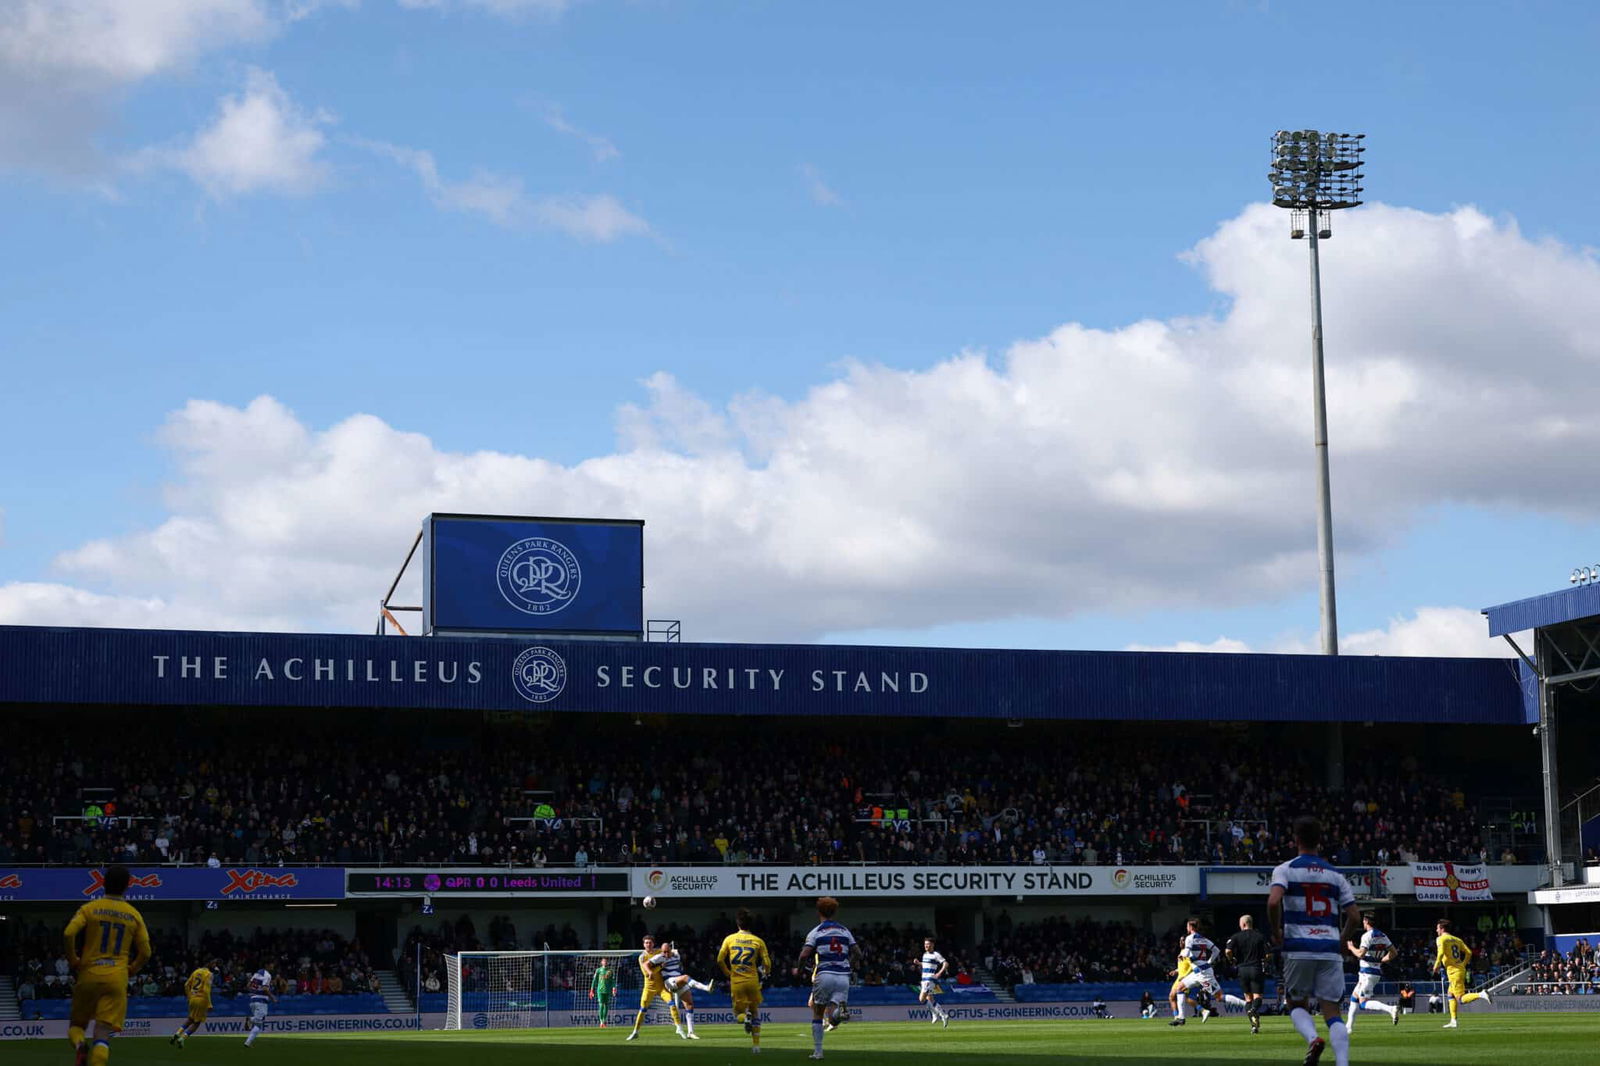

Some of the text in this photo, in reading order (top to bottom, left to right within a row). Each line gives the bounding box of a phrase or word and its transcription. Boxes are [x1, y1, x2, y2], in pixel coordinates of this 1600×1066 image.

[501, 540, 578, 579] QUEENS PARK RANGERS
[527, 603, 551, 611] 1882
[152, 655, 930, 694] THE ACHILLEUS SECURITY STAND
[220, 869, 298, 895] Xtra
[374, 876, 412, 888] 14:13
[446, 876, 471, 889] QPR
[476, 876, 484, 888] 0
[490, 876, 498, 888] 0
[503, 876, 537, 888] Leeds
[541, 876, 581, 888] United
[671, 875, 718, 883] ACHILLEUS
[737, 873, 1093, 891] THE ACHILLEUS SECURITY STAND
[1301, 882, 1332, 917] 15
[100, 920, 126, 956] 11
[829, 936, 843, 954] 4
[731, 946, 755, 965] 22
[1452, 945, 1459, 959] 8
